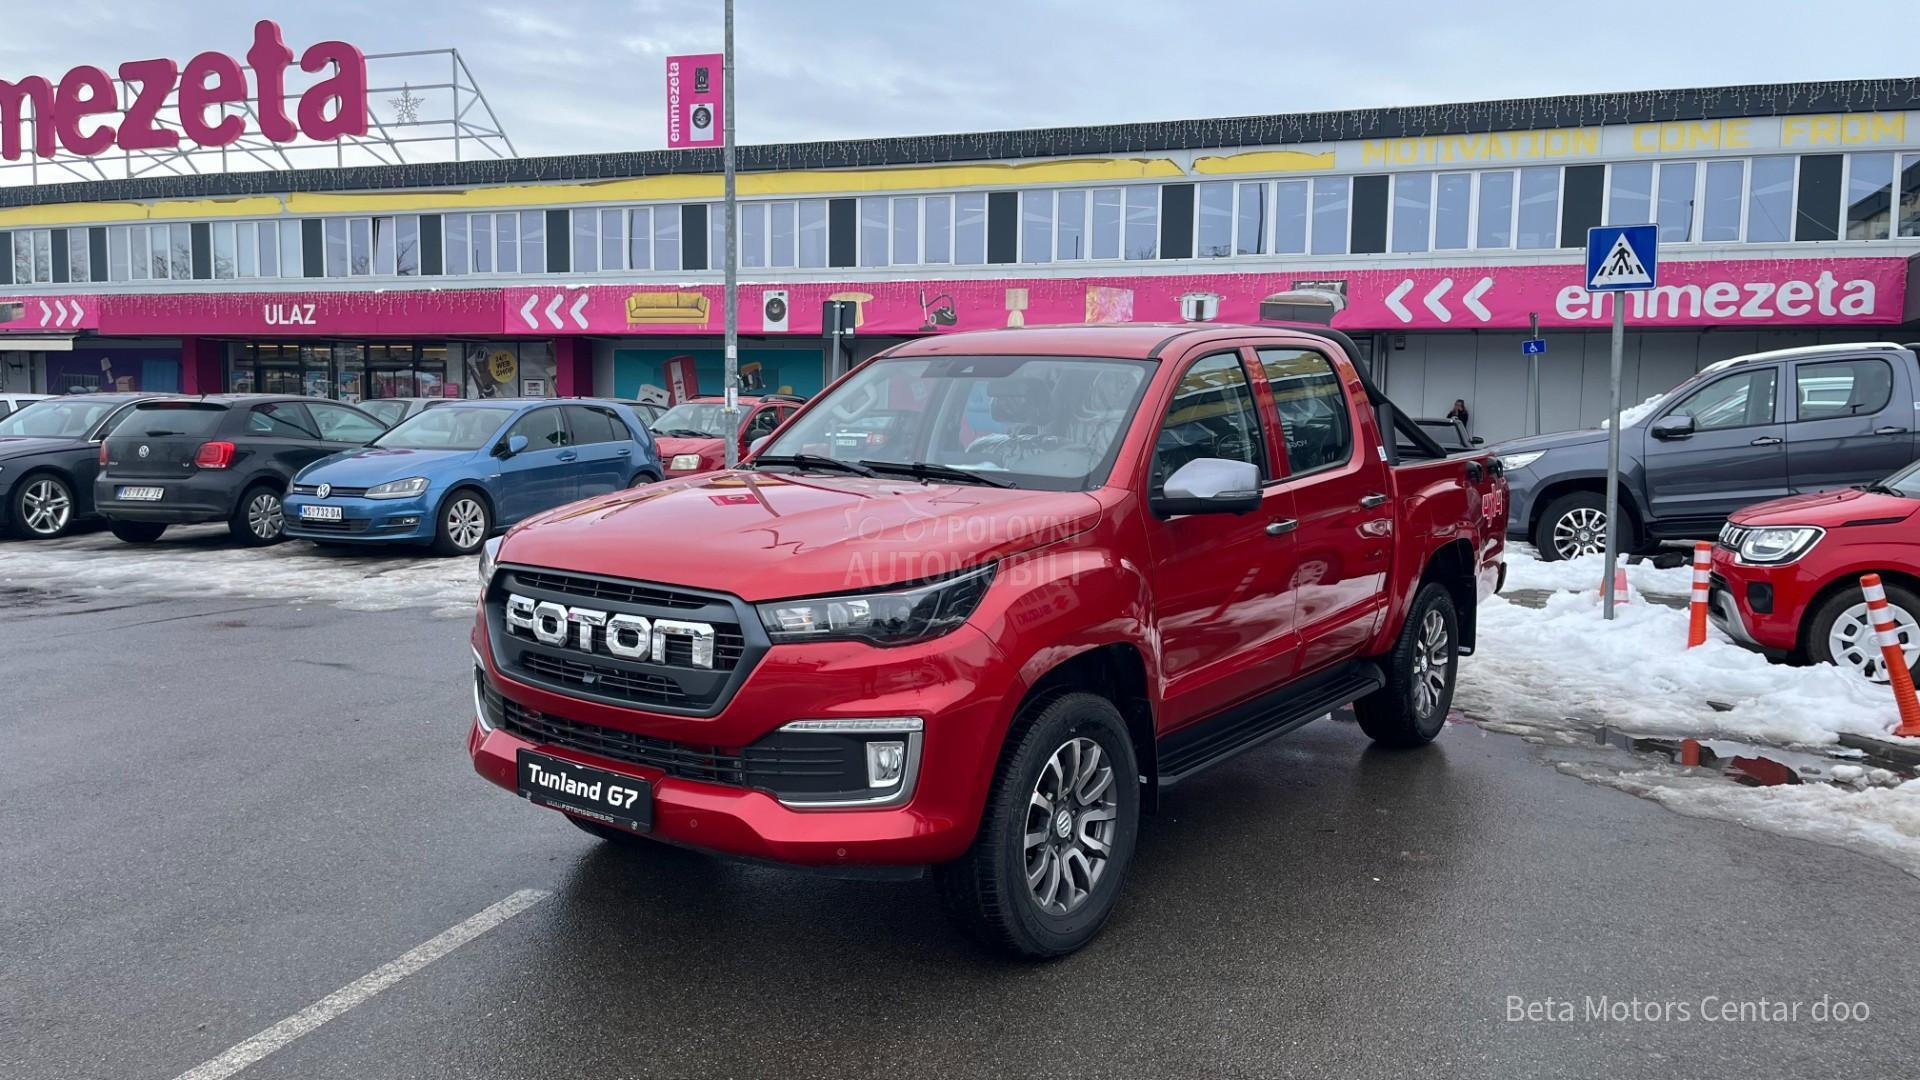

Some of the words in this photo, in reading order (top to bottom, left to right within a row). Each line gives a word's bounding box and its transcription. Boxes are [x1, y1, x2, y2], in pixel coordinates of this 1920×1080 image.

[668, 62, 680, 142] emmezeta
[1362, 127, 1599, 166] MOTIVATION
[1632, 118, 1750, 151] COME
[1781, 111, 1906, 145] FROM
[264, 303, 317, 325] ULAZ
[303, 507, 312, 517] NS
[316, 507, 329, 518] 732
[506, 593, 715, 669] FOTON
[528, 763, 602, 801] Tunland
[607, 785, 639, 809] G7
